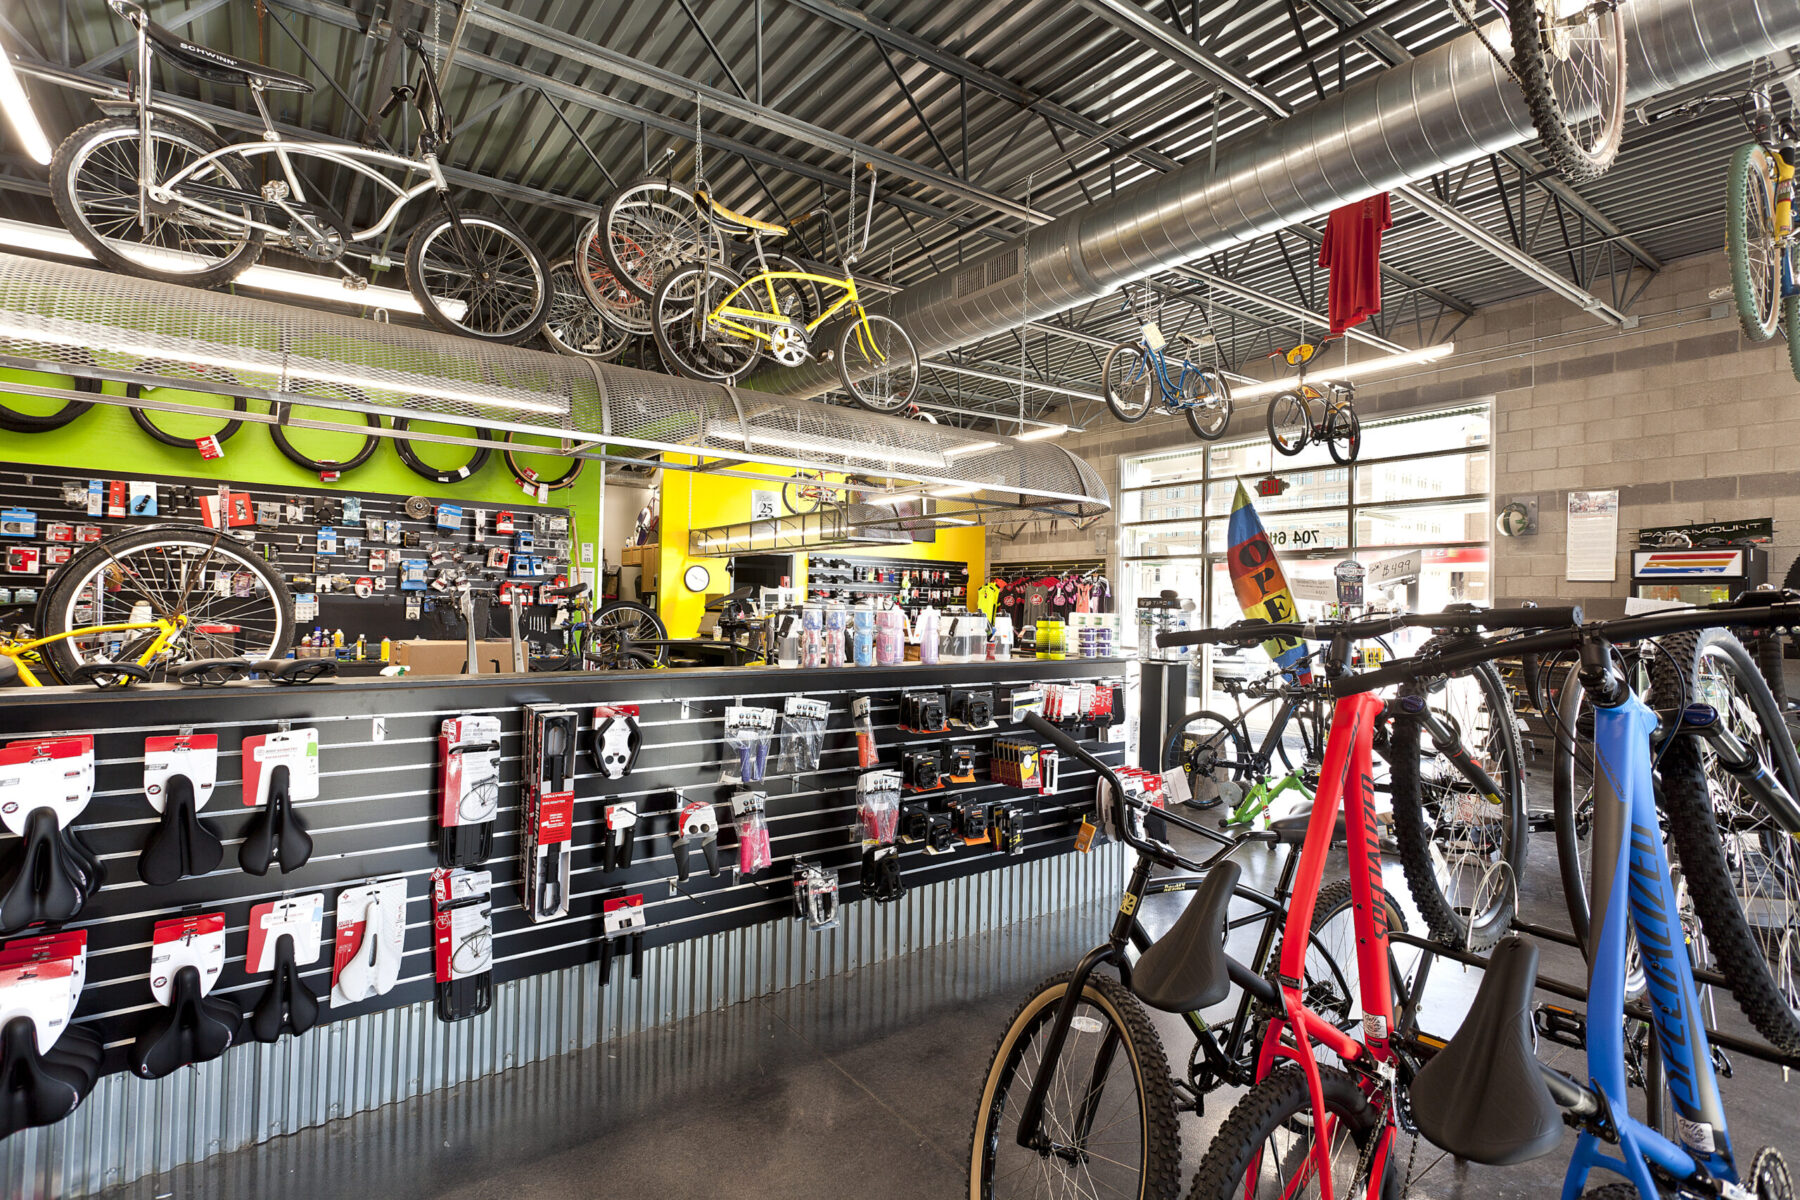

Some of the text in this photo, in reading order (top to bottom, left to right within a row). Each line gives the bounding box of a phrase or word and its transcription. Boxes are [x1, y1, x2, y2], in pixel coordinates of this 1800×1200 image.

[180, 42, 235, 66] SCHWINN
[1262, 480, 1280, 495] EXIT
[760, 502, 773, 513] 25
[1361, 773, 1388, 940] SPECIALIZED
[1629, 825, 1694, 1103] SPECIALIZED
